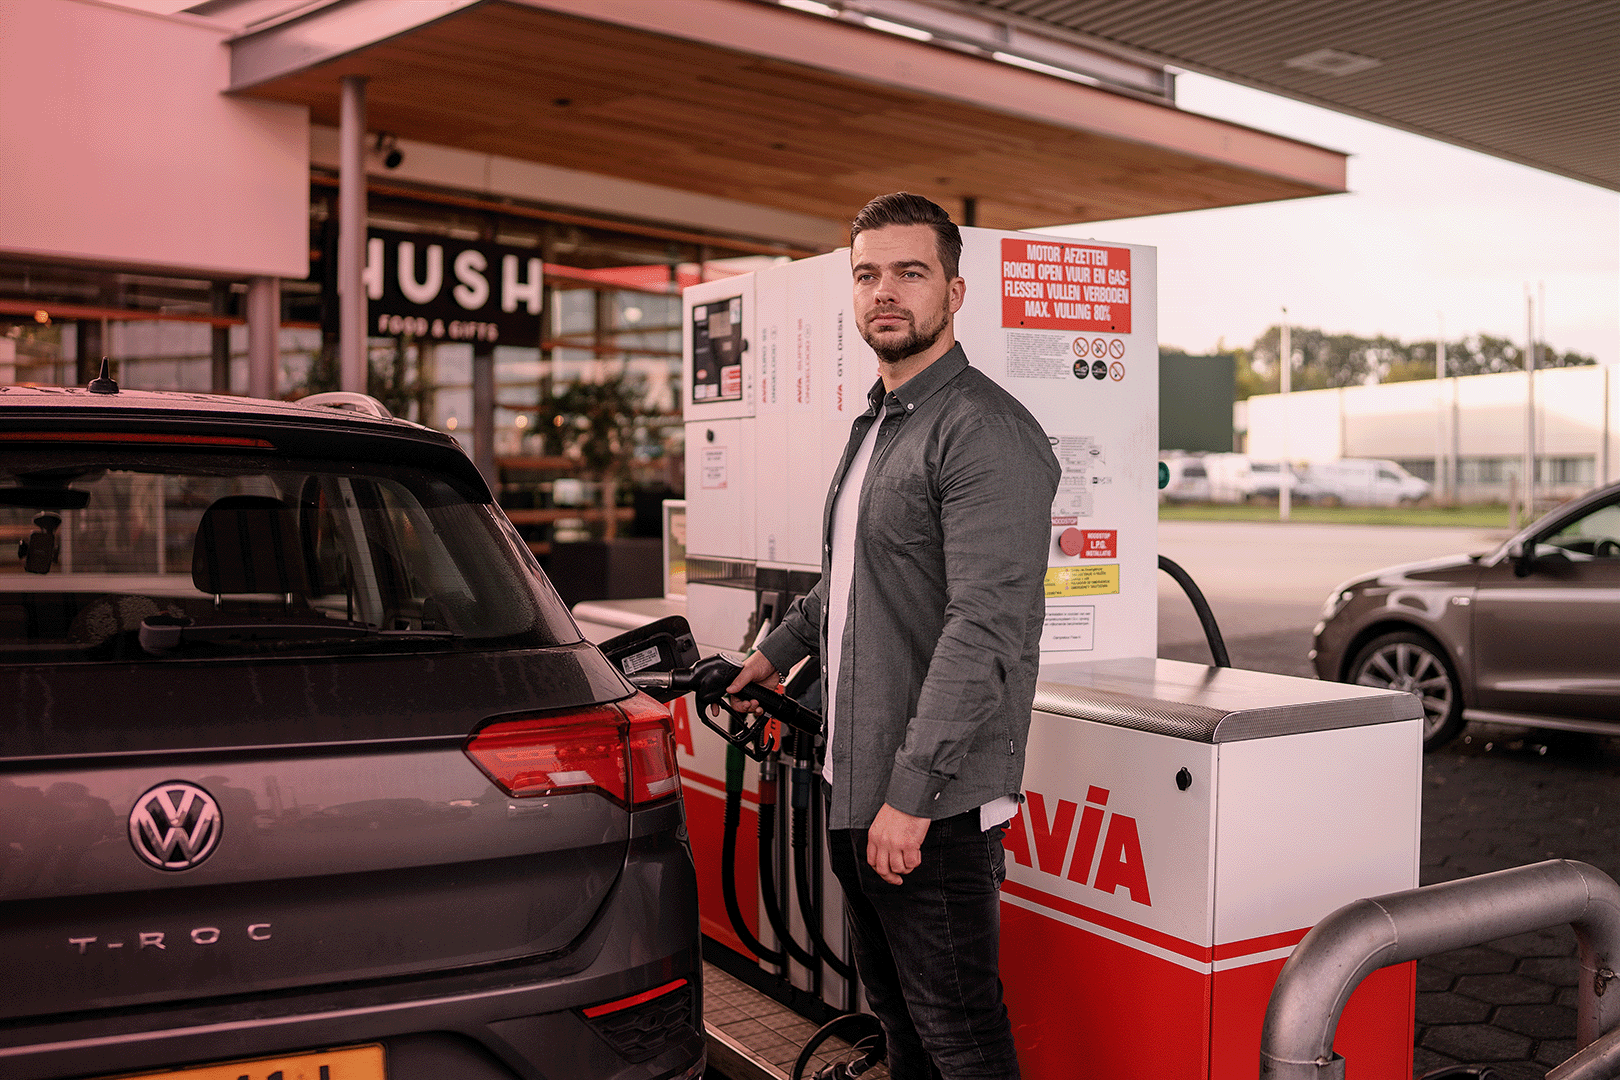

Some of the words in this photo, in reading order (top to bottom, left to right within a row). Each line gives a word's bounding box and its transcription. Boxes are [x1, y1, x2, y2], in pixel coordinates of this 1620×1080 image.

[1027, 244, 1061, 262] MOTOR
[1064, 247, 1108, 266] AFZETTEN
[1003, 261, 1035, 279] ROKEN
[1038, 264, 1063, 281] OPEN
[1065, 266, 1091, 283] VUUR
[1093, 268, 1106, 284] EN
[1108, 269, 1130, 286] GAS-
[1004, 280, 1044, 299] FLESSEN
[1047, 282, 1080, 301] VULLEN
[1083, 285, 1129, 304] VERBODEN
[1025, 300, 1050, 318] MAX.
[1053, 302, 1091, 320] VULLING
[1093, 304, 1111, 321] 80%
[378, 314, 429, 337] FOOD
[431, 318, 445, 338] &
[448, 320, 499, 342] GIFTS
